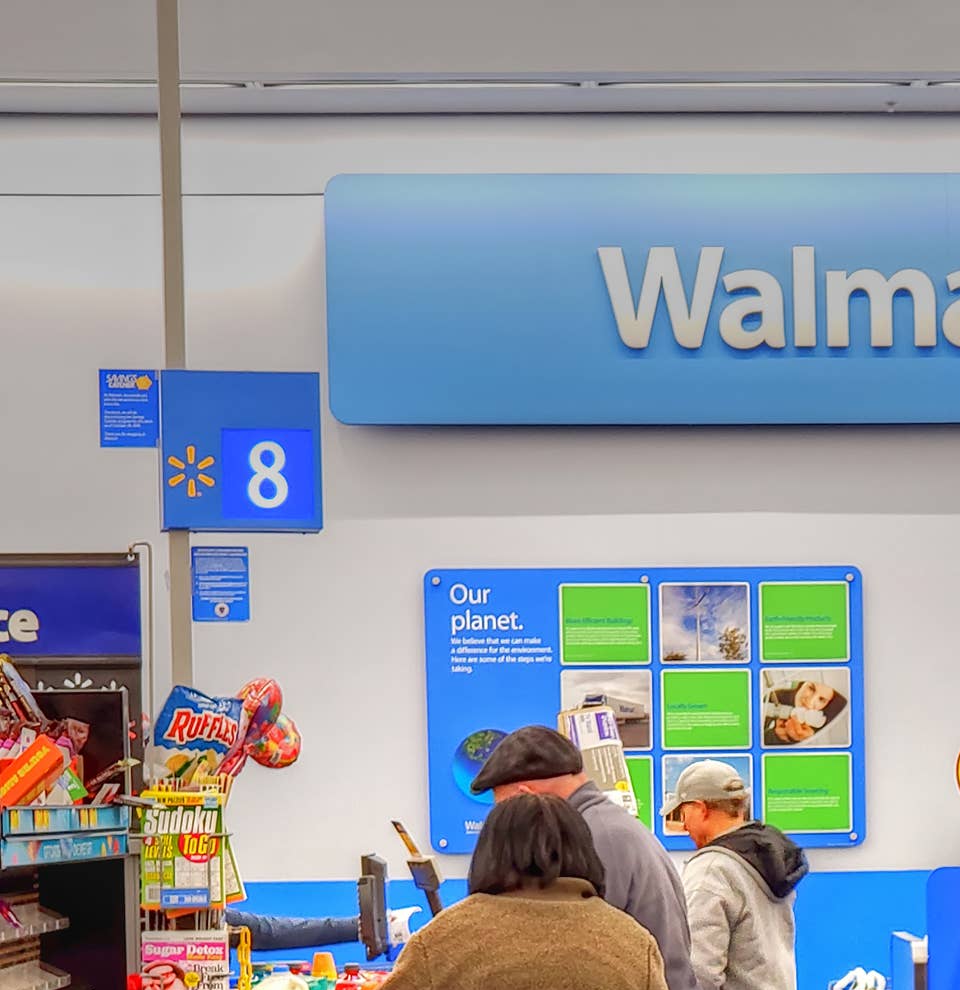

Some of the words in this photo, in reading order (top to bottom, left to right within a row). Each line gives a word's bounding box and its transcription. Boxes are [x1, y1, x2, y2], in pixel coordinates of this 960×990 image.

[248, 441, 289, 509] 8
[449, 584, 491, 605] Our
[451, 609, 524, 636] planet.
[167, 710, 239, 746] RUFFLES
[144, 805, 218, 834] Sudoku
[145, 944, 185, 957] Sugar
[186, 944, 224, 955] Detox
